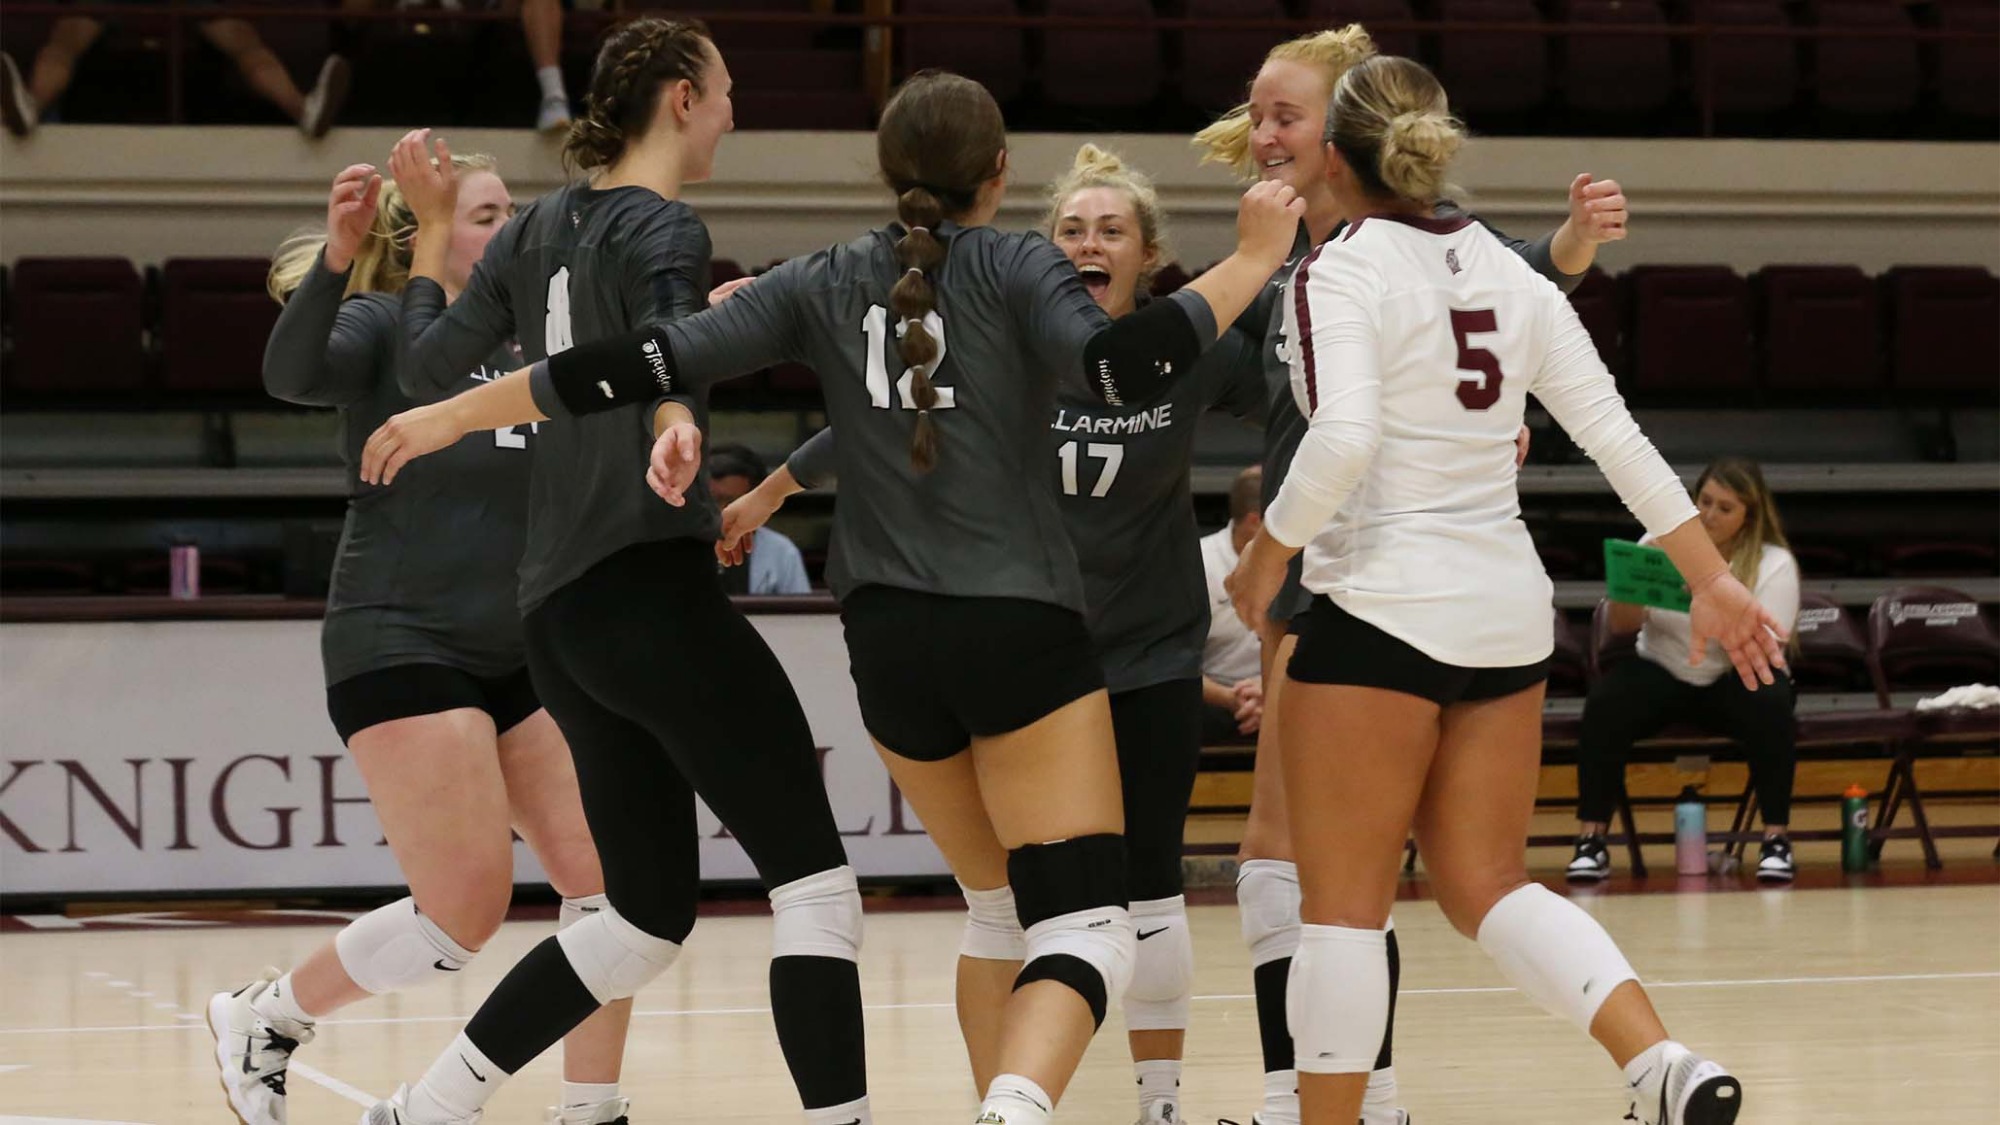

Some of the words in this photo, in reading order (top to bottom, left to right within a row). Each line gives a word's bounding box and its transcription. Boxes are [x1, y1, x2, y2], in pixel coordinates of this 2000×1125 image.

[862, 304, 956, 409] 12
[1449, 309, 1504, 412] 5
[1051, 403, 1173, 435] LARMINE
[1058, 441, 1124, 498] 17
[0, 754, 524, 853] KNIGH
